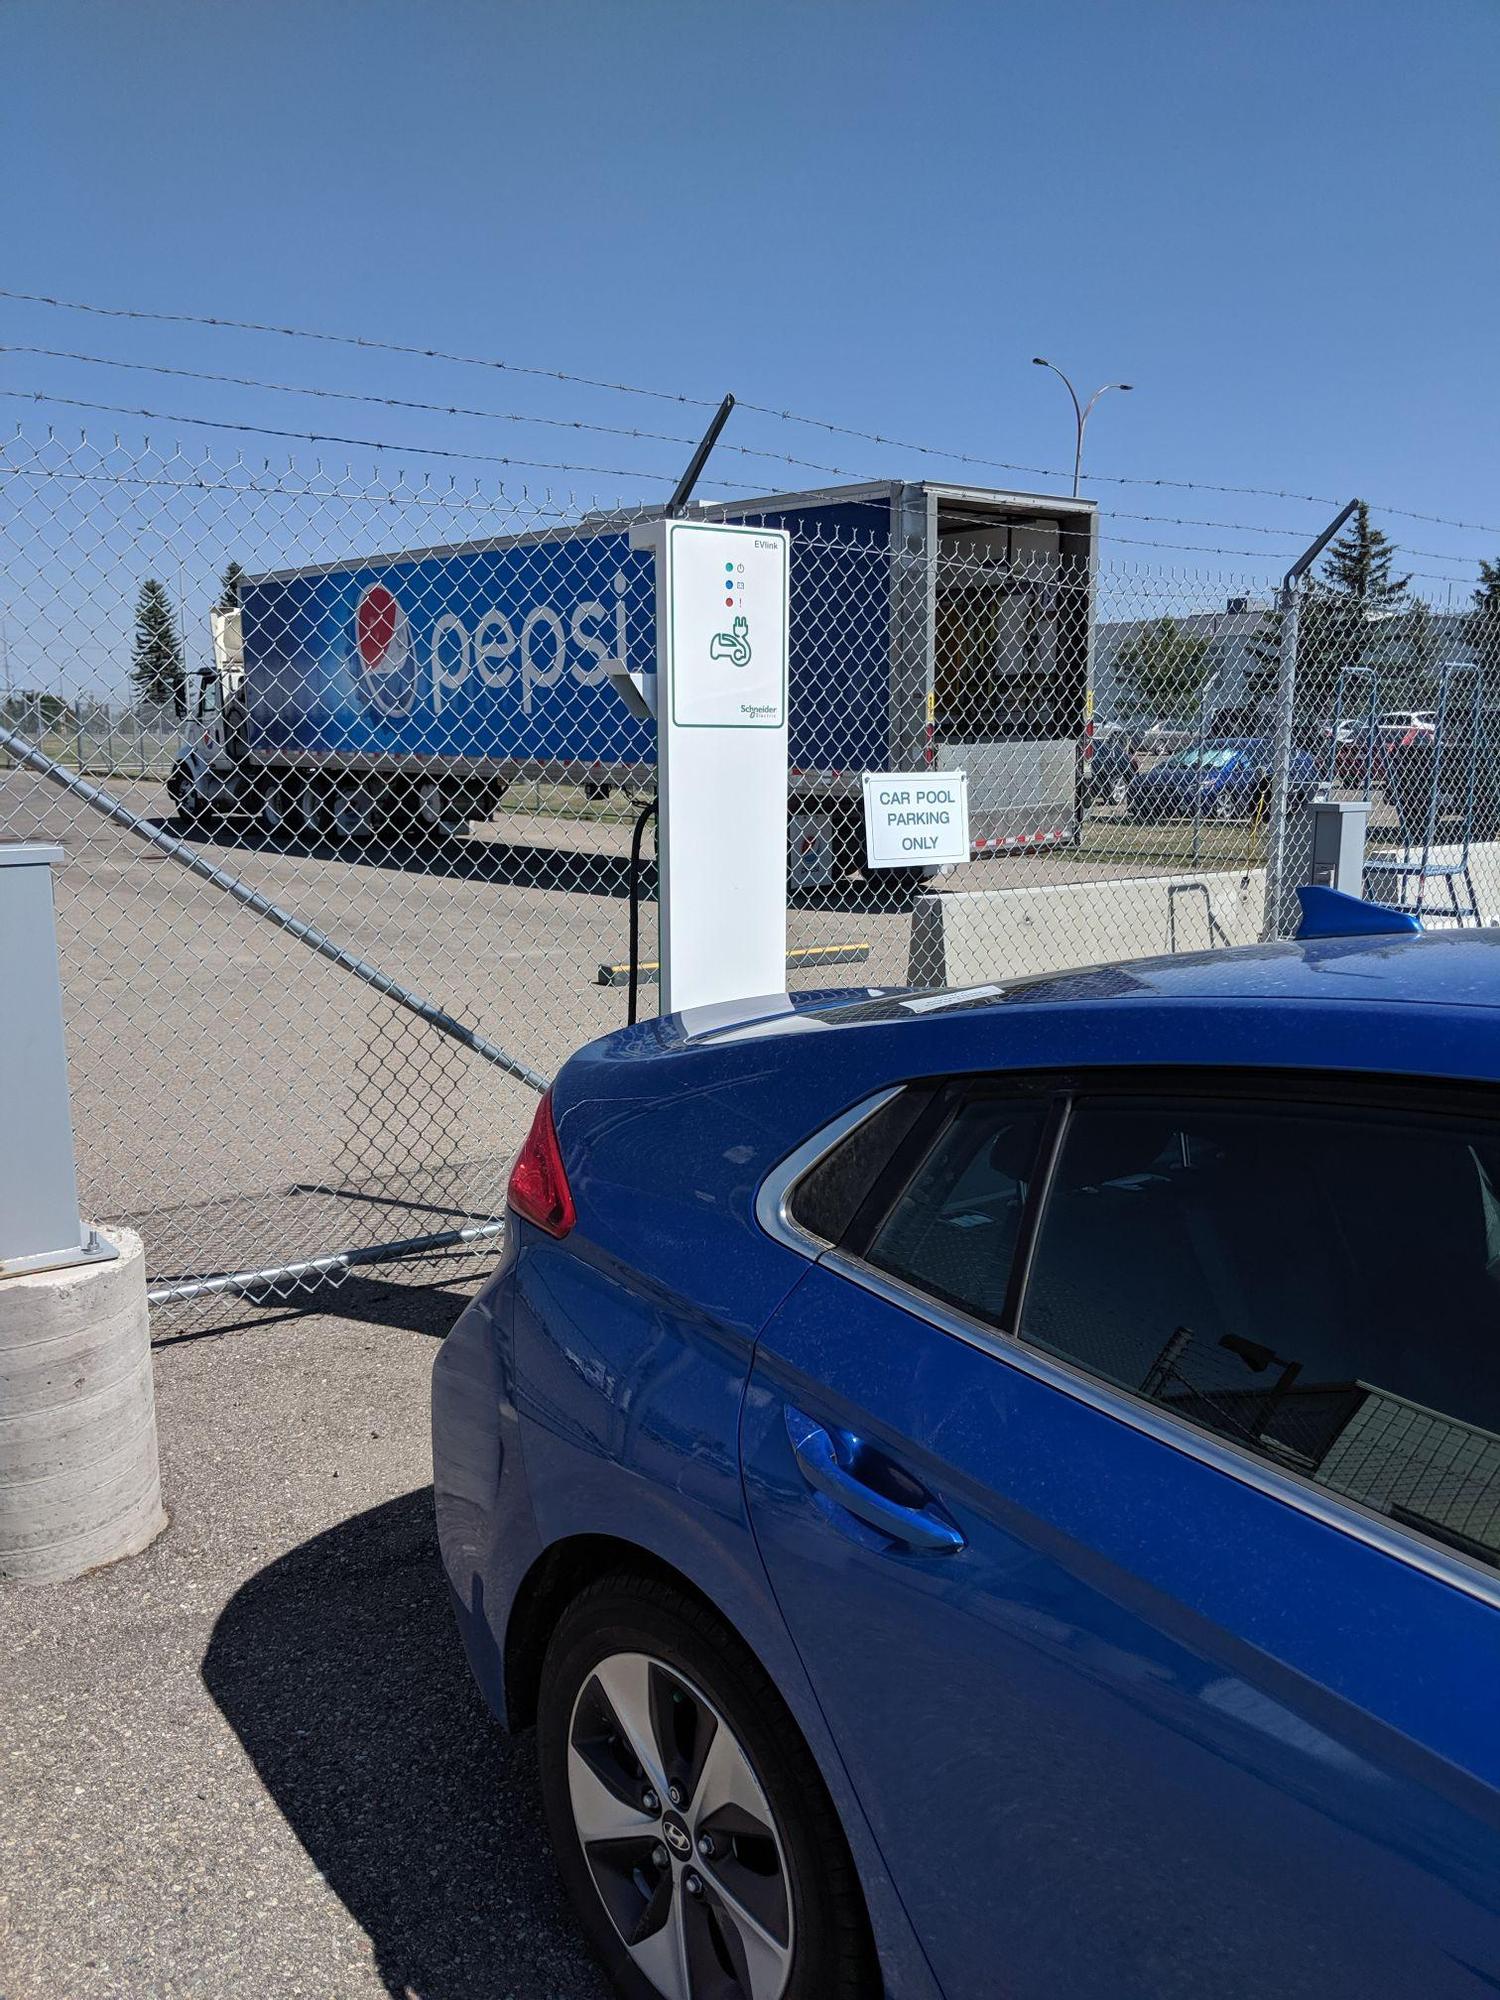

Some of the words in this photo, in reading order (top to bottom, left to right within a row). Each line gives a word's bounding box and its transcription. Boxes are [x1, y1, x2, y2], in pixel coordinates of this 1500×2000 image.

[754, 540, 778, 550] EVlink
[431, 572, 628, 714] pepsi
[740, 704, 777, 713] Schneider
[880, 791, 911, 805] CAR
[916, 790, 956, 805] POOL
[887, 811, 950, 826] PARKING
[901, 836, 938, 851] ONLY
